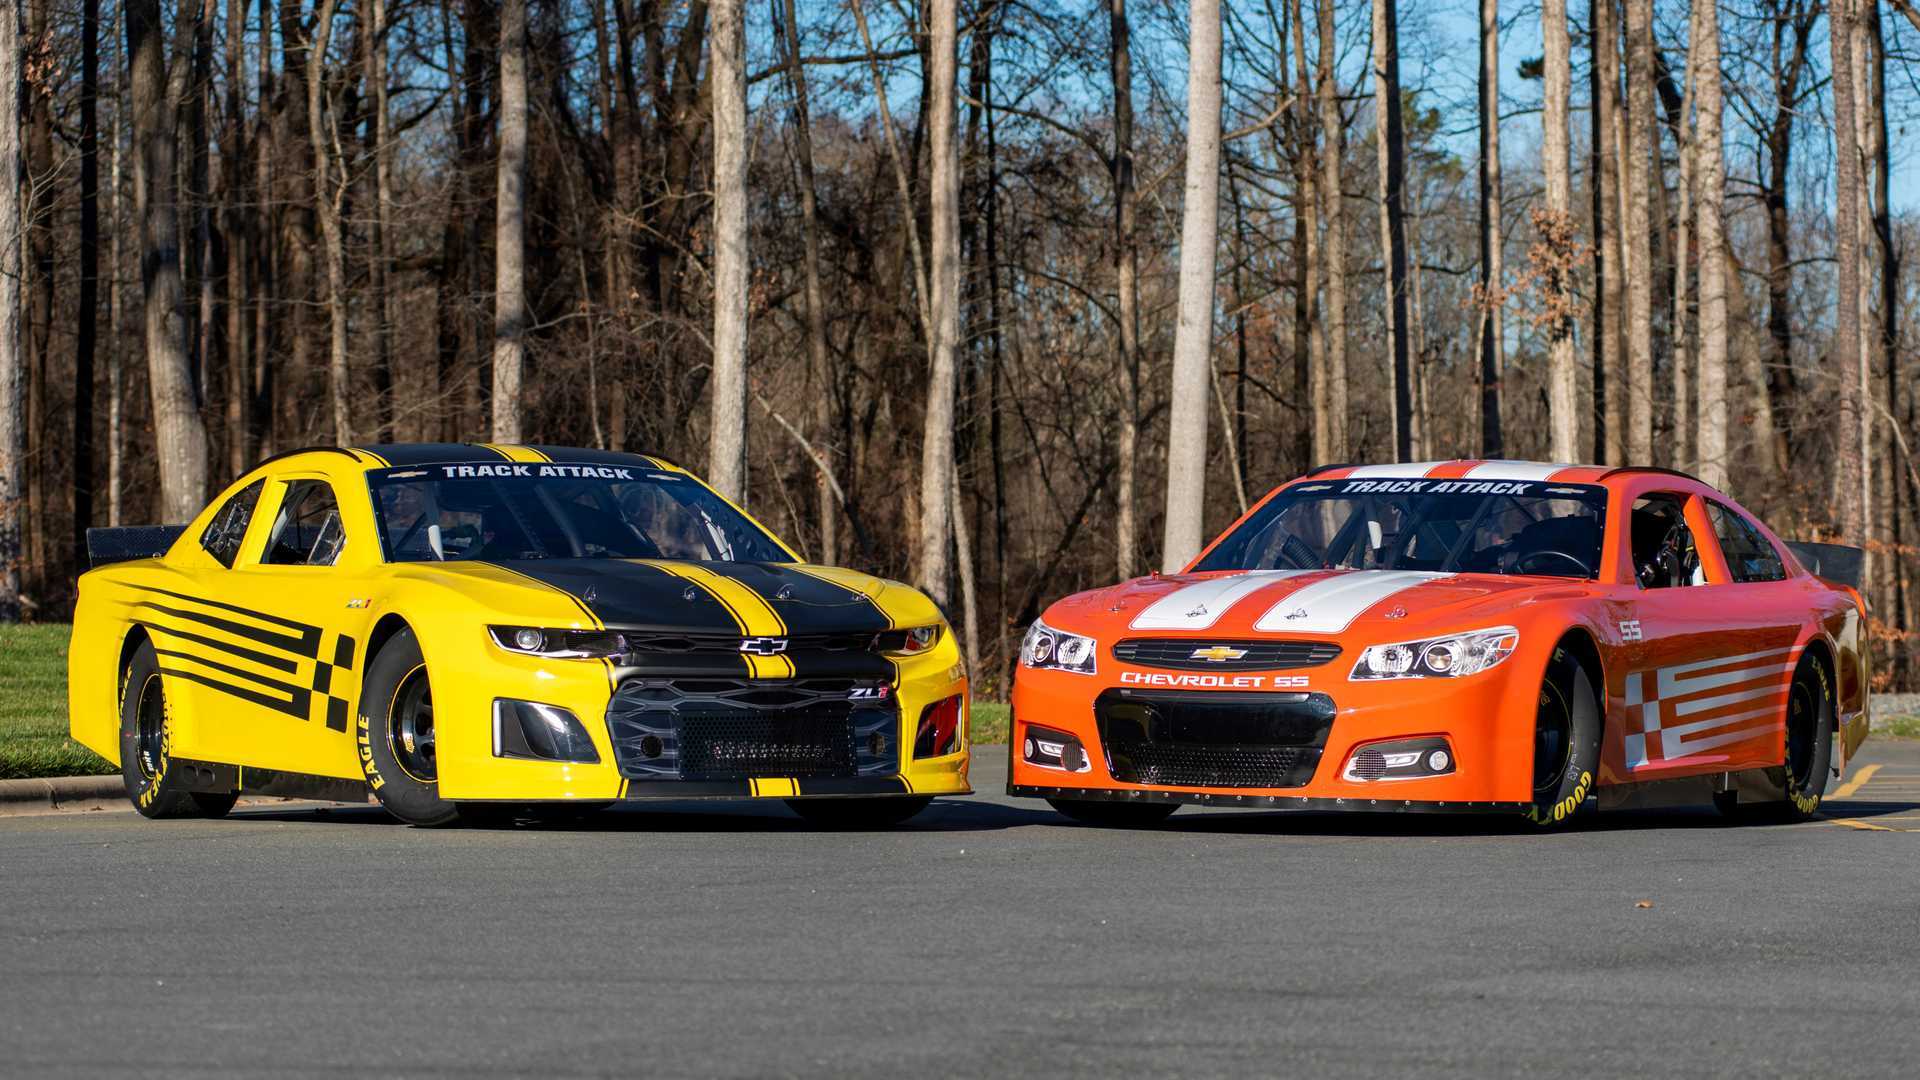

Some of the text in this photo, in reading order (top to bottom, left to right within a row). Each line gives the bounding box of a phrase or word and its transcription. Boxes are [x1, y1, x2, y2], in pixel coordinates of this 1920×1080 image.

[442, 465, 634, 480] TRACK ATTACK
[1341, 481, 1533, 495] TRACK ATTACK
[1619, 620, 1642, 641] SS
[1120, 671, 1310, 688] CHEVROLET SS
[847, 687, 888, 700] ZL1
[358, 713, 386, 791] EAGLE
